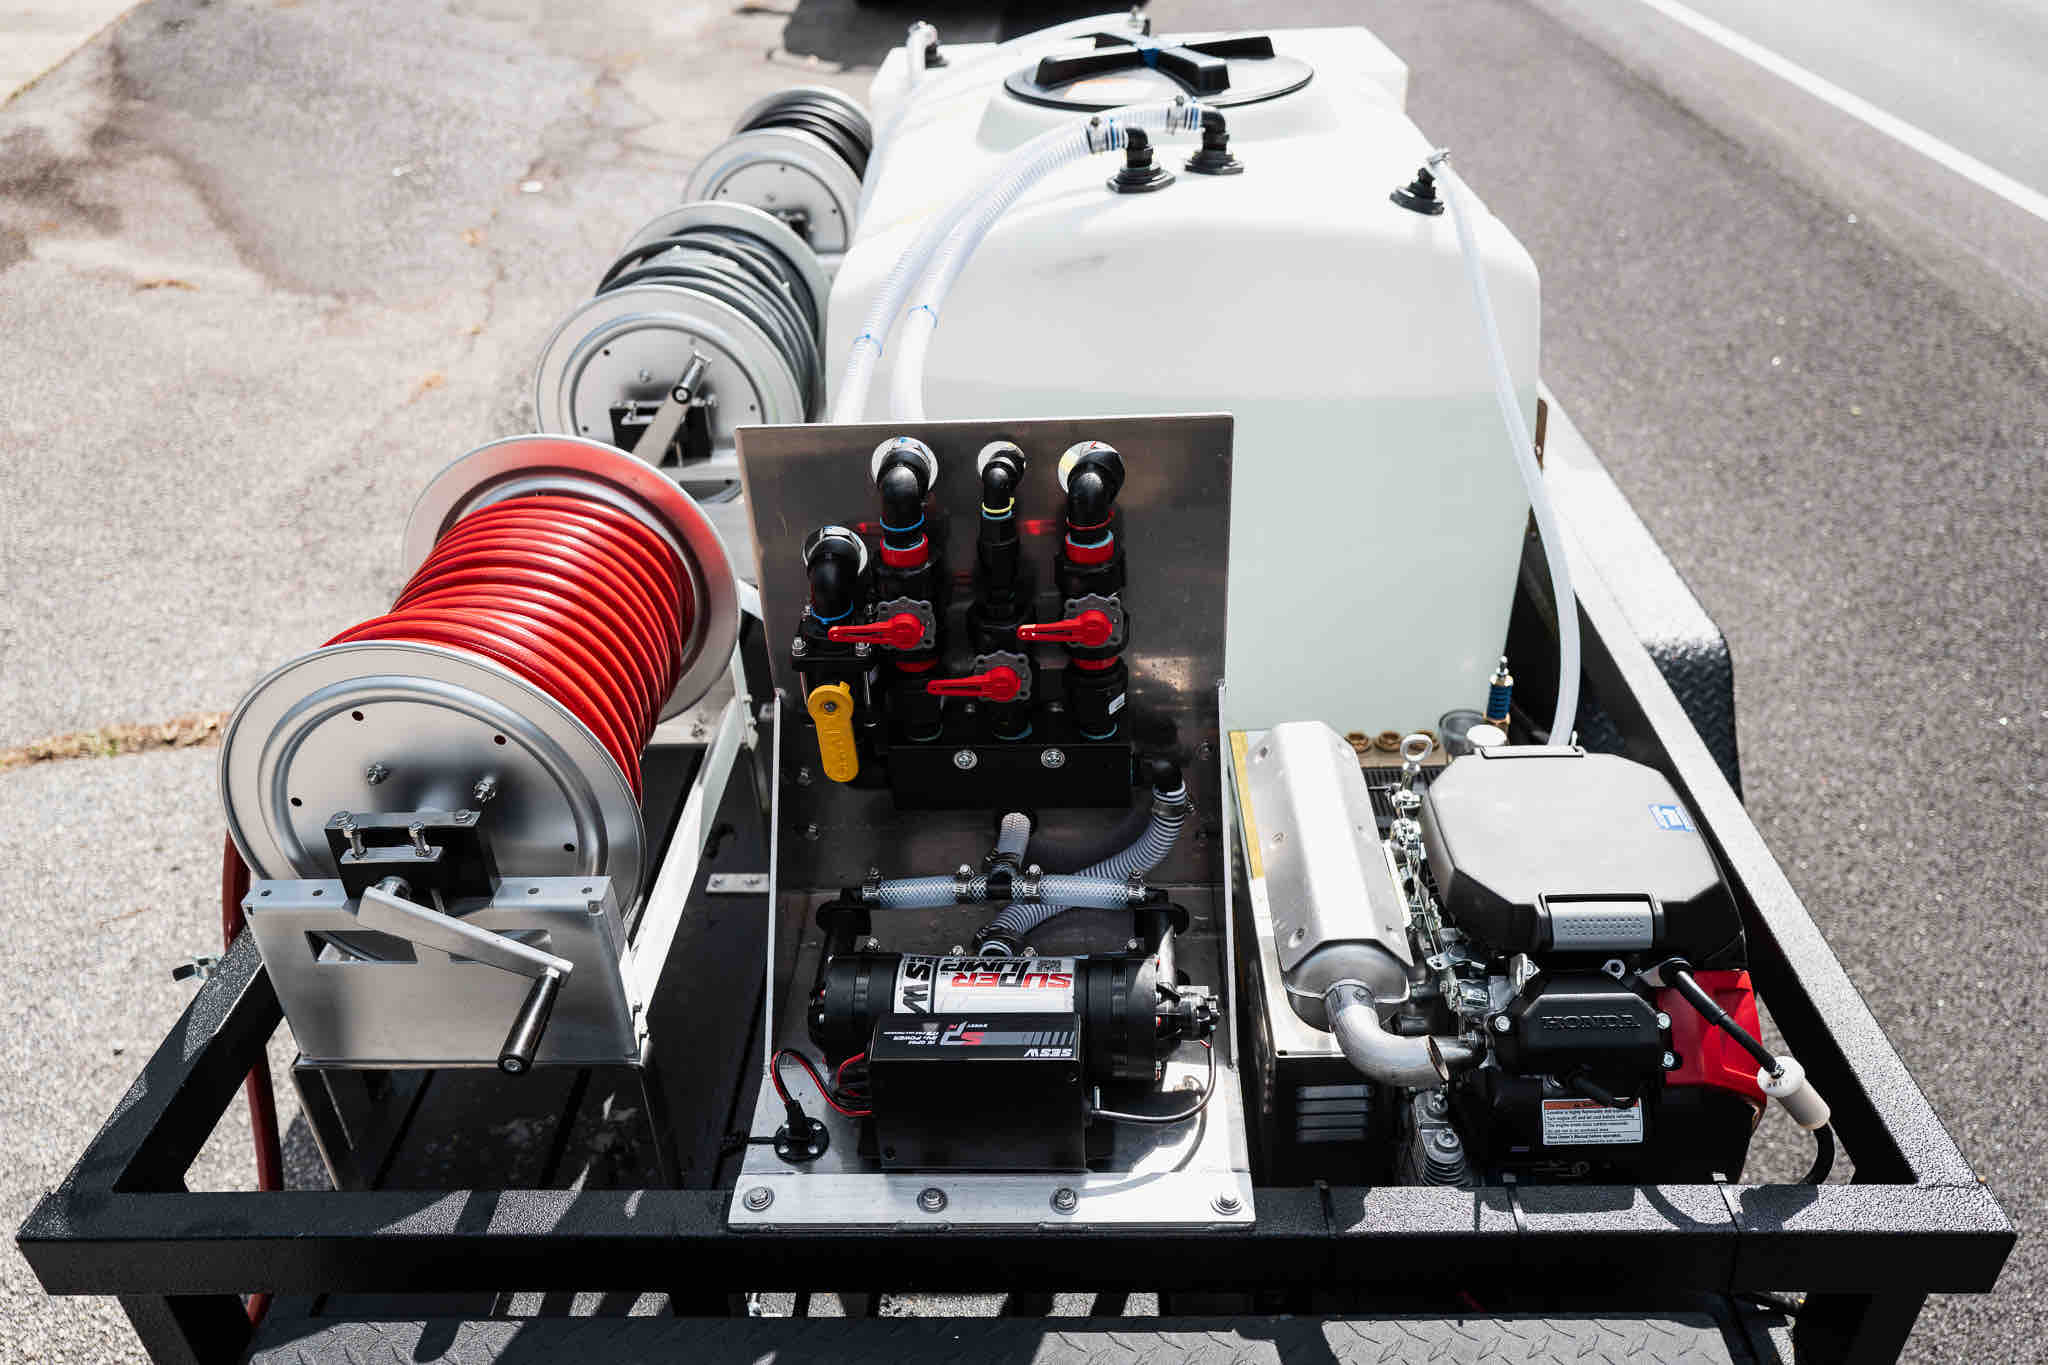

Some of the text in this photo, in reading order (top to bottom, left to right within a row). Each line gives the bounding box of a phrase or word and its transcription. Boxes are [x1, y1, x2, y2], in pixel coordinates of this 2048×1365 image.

[952, 970, 1073, 988] SUPER
[1538, 1015, 1641, 1031] HONDA
[1024, 1048, 1072, 1057] SESW
